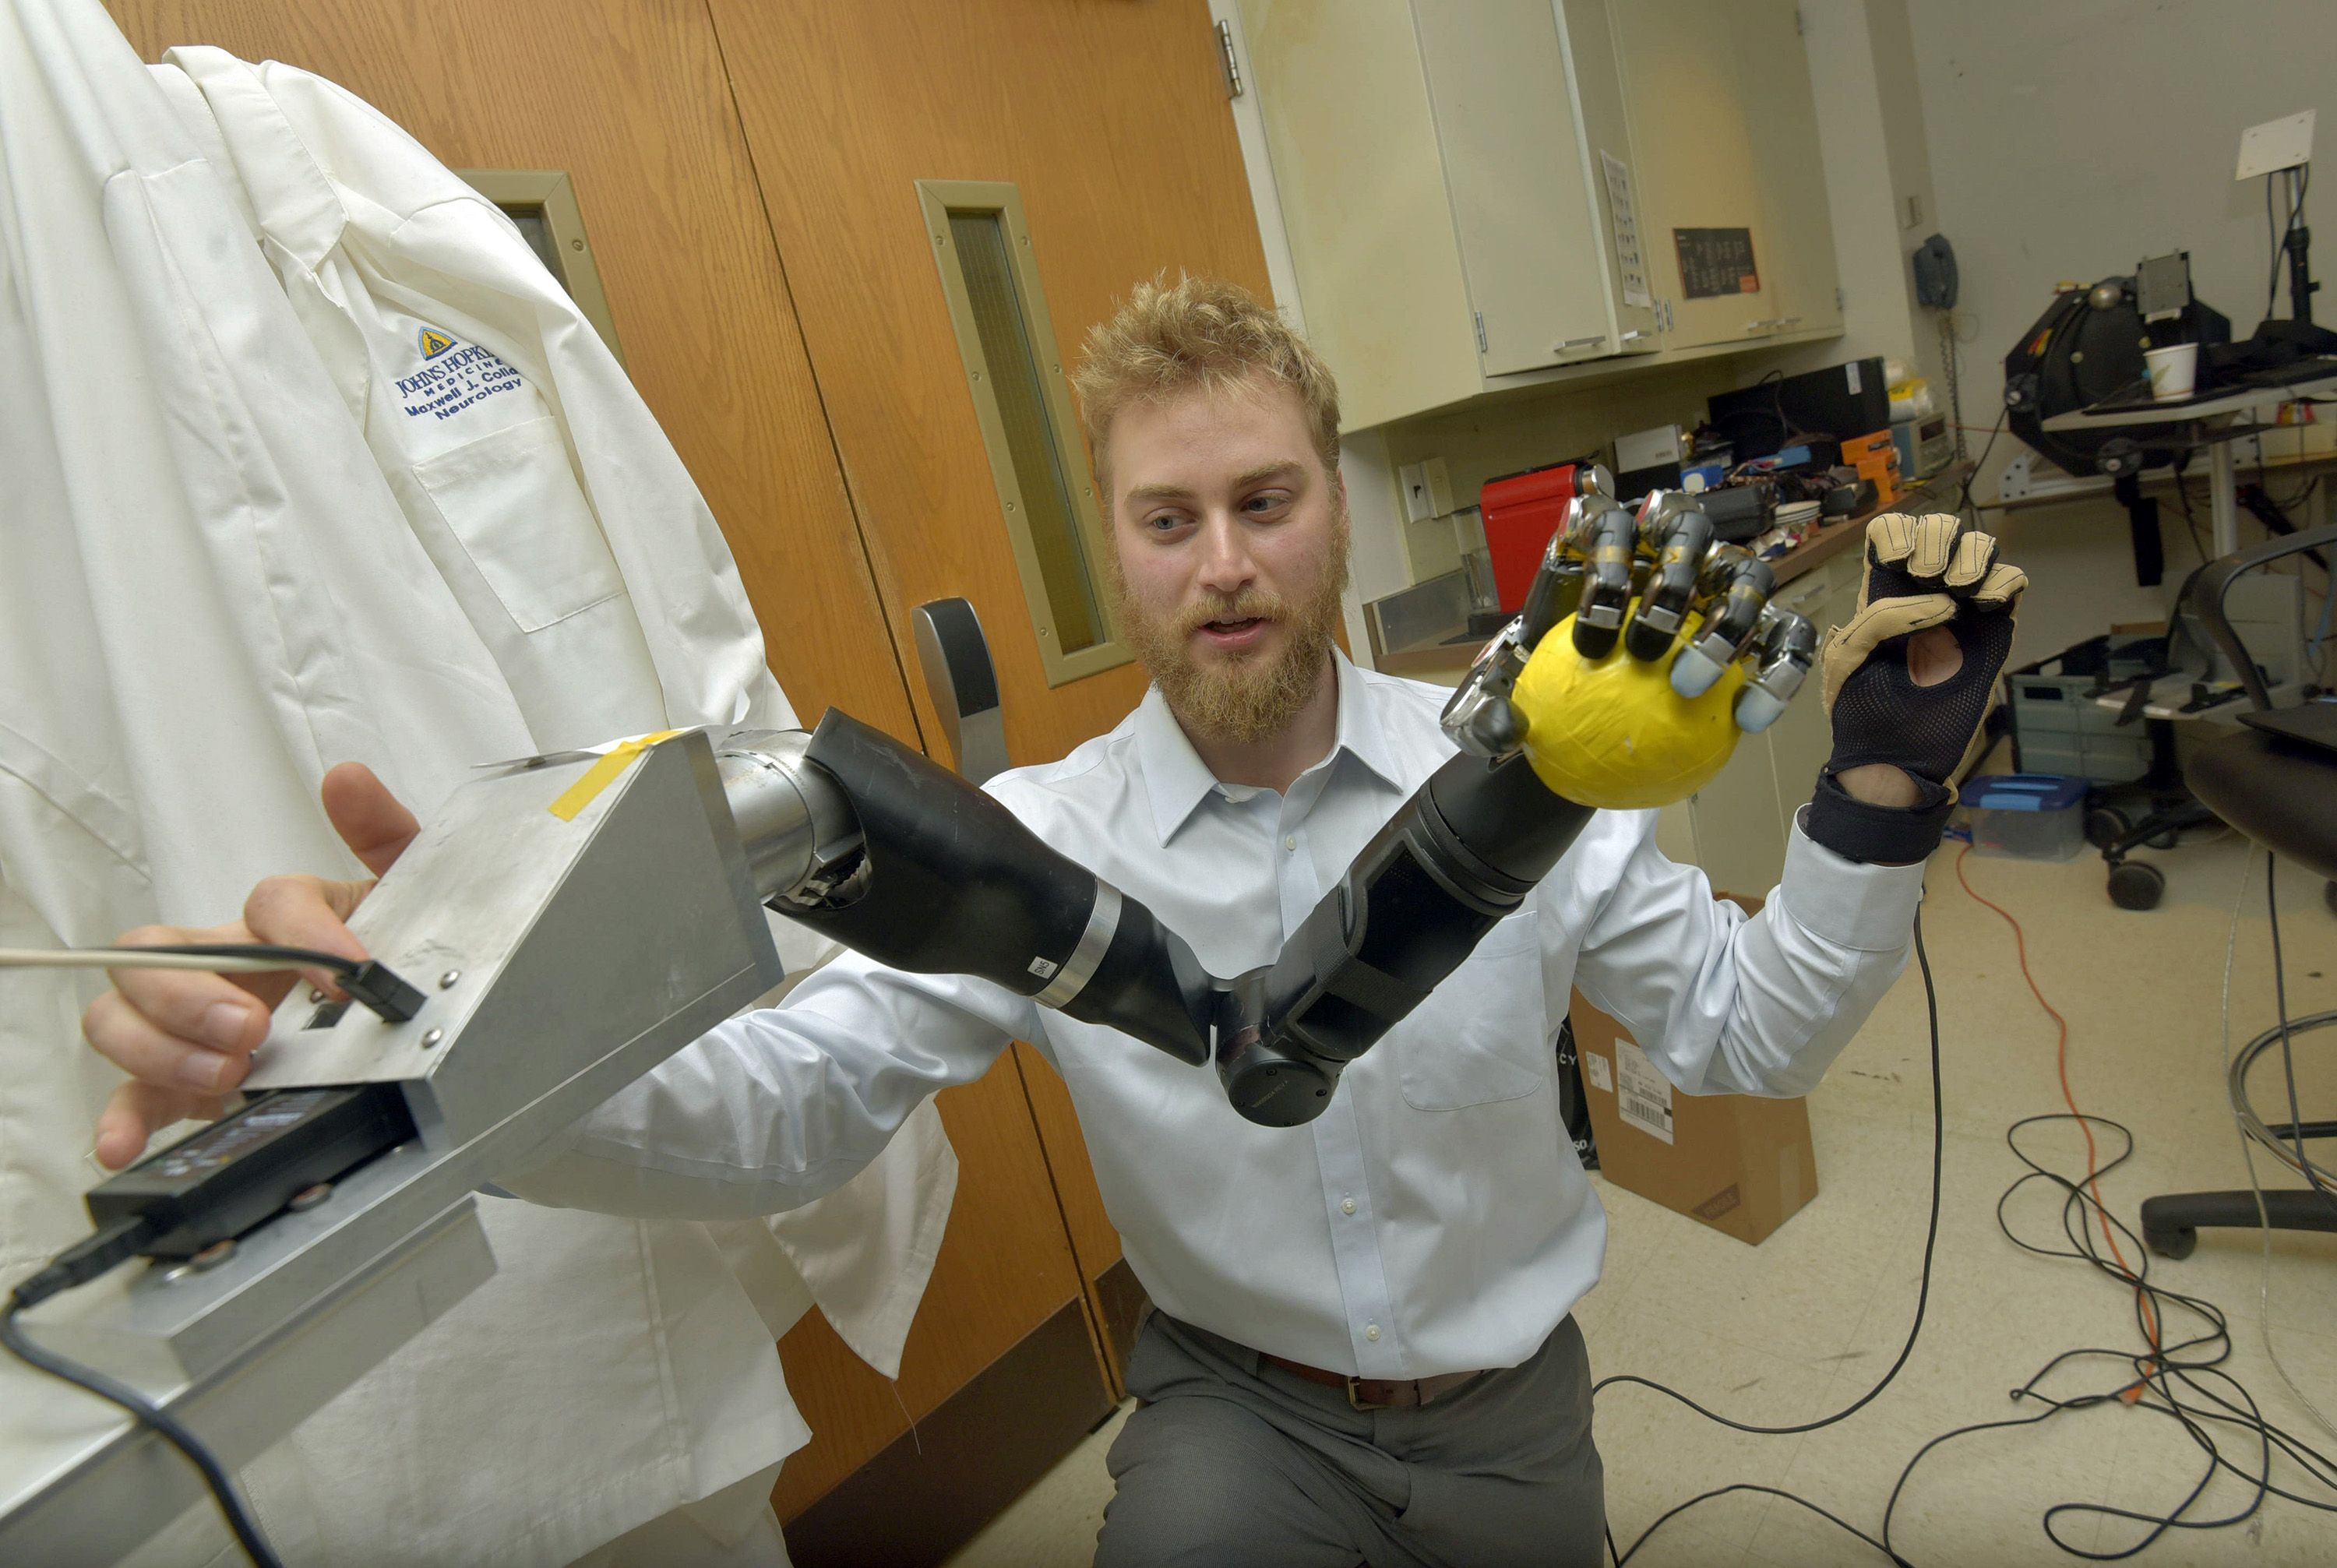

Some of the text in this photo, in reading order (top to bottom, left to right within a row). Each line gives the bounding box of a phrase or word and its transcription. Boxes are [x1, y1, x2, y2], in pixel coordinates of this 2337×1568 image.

[395, 365, 446, 399] JOHNS
[424, 358, 504, 396] MEDICINE
[404, 386, 462, 417] Maxwell
[466, 379, 480, 392] J.
[435, 378, 522, 420] Neurology
[1035, 960, 1049, 974] SN5
